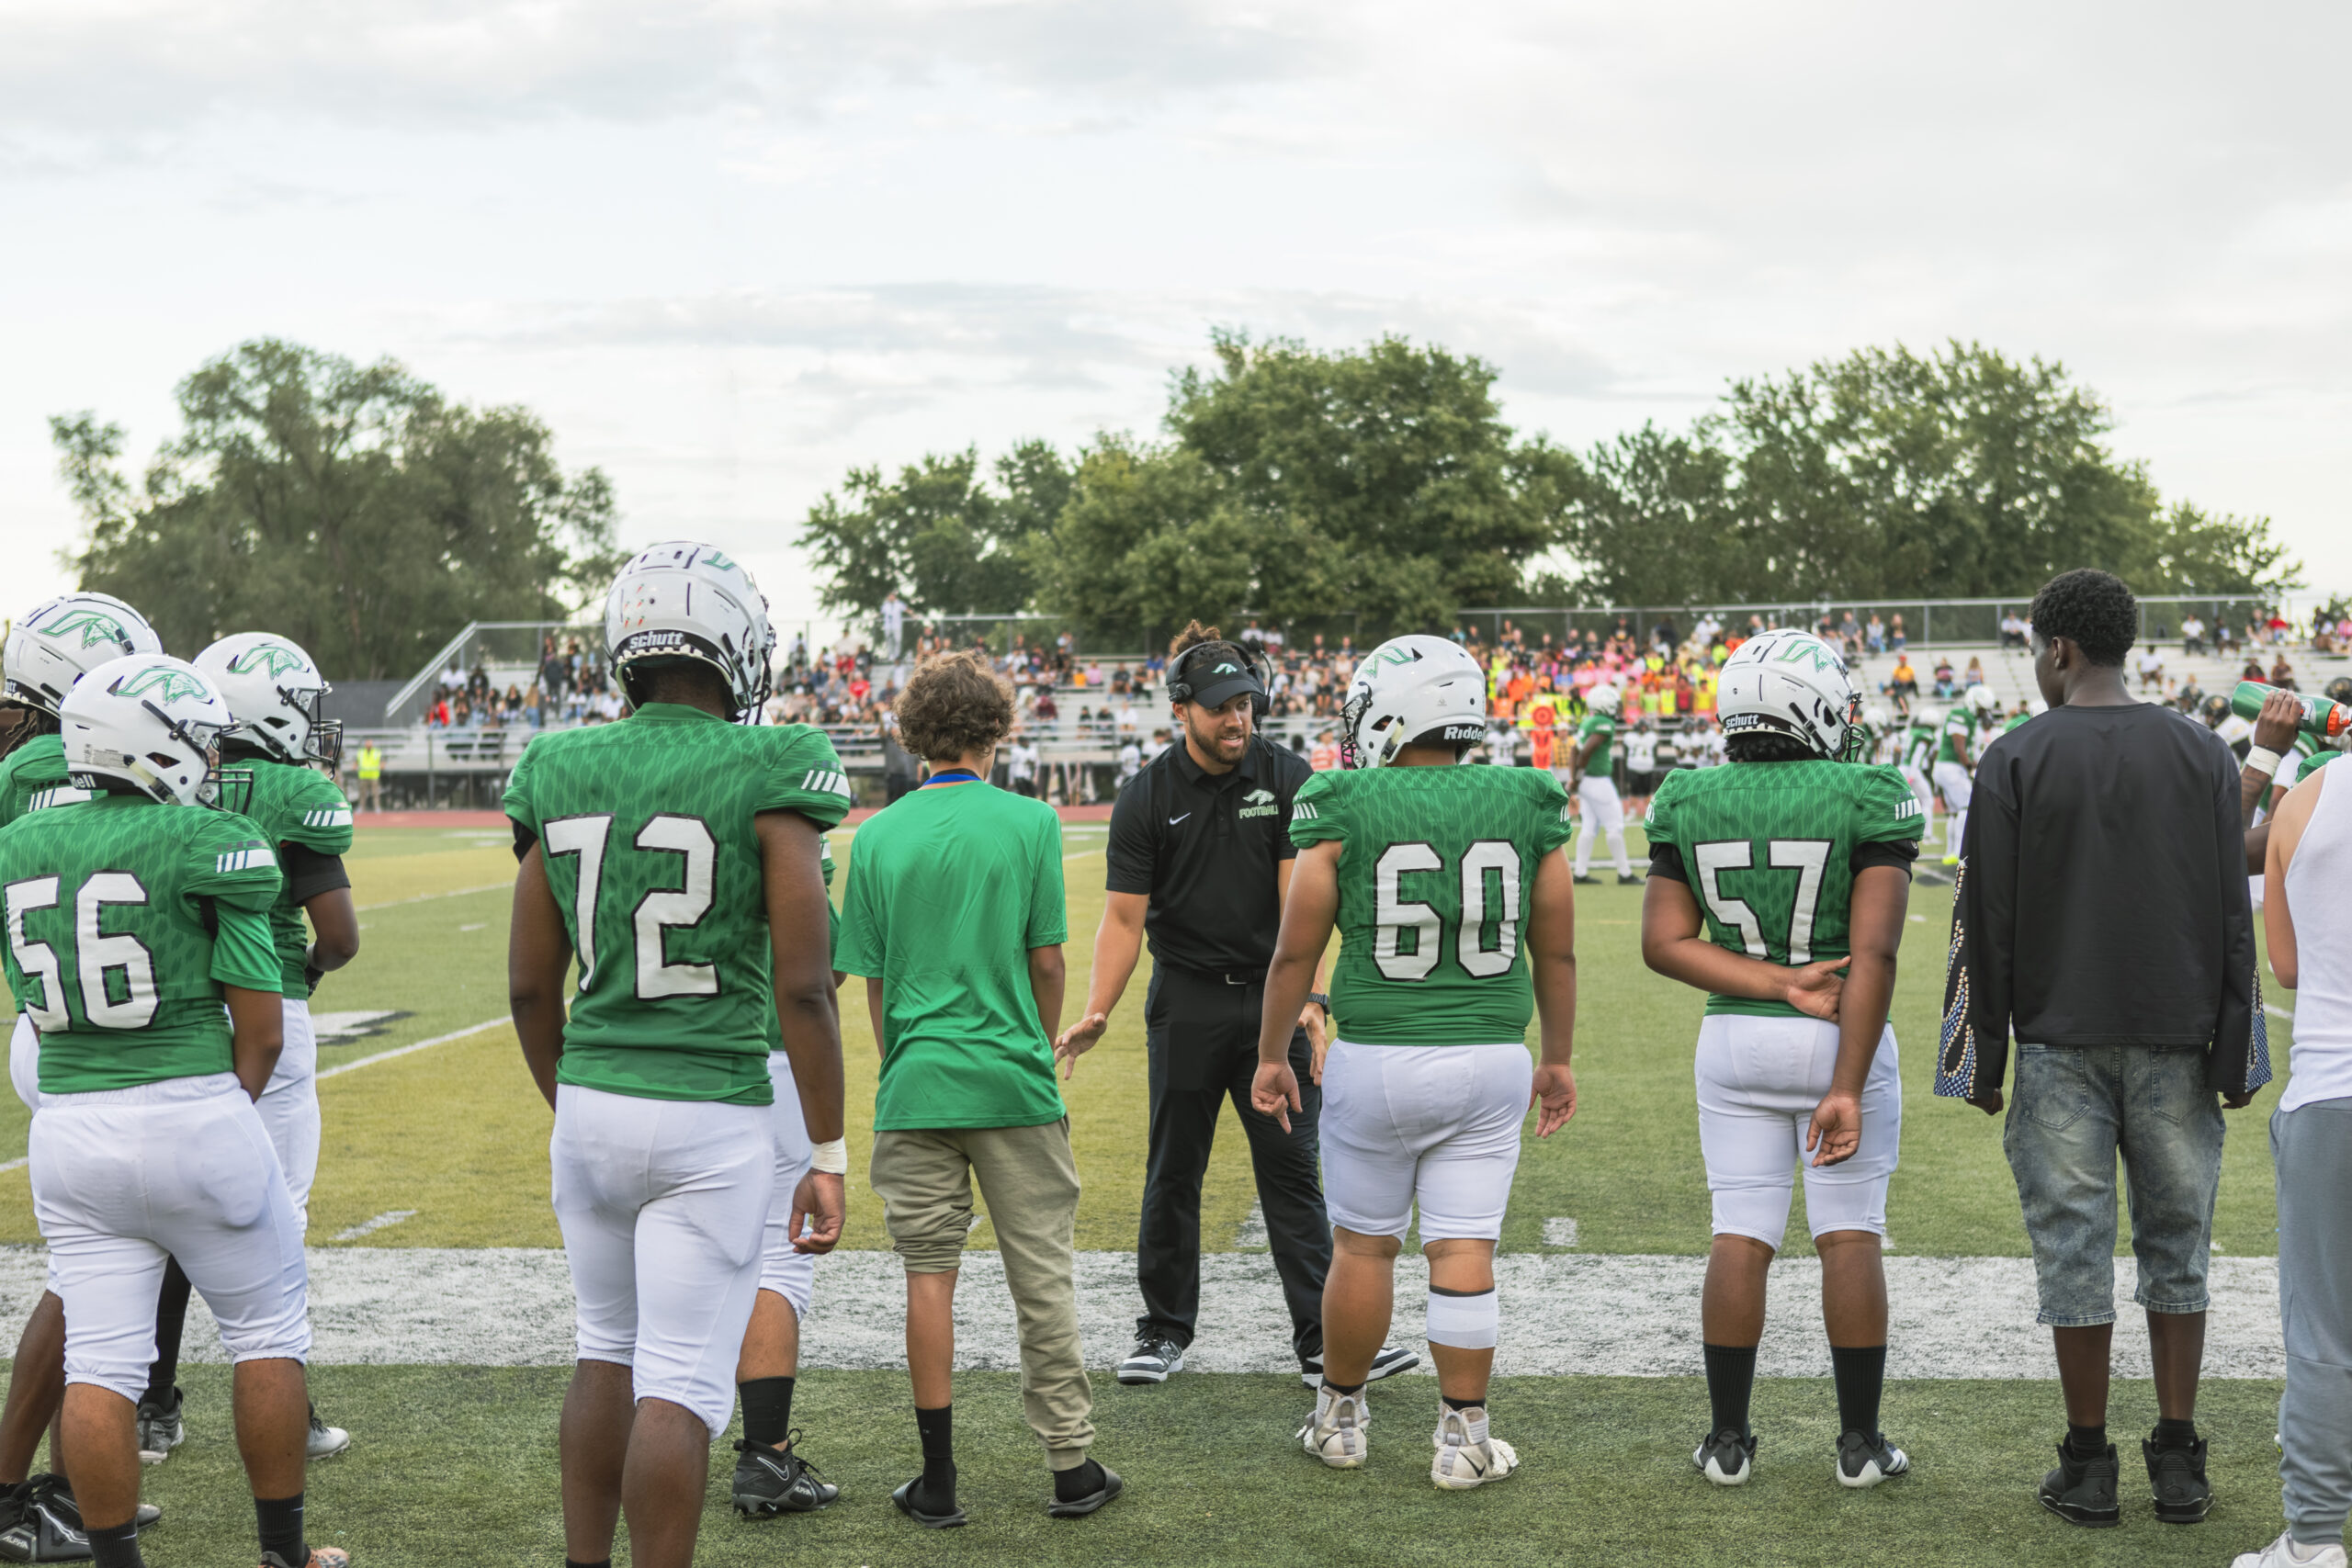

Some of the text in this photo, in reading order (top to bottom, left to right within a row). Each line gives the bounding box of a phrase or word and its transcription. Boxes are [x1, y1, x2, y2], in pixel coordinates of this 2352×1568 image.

[629, 630, 684, 649] schutt
[1725, 714, 1759, 728] schutt
[1238, 804, 1279, 819] FOOTBALL
[542, 811, 721, 1002] 72
[1372, 838, 1521, 983] 60
[1692, 837, 1836, 965] 57
[3, 869, 162, 1034] 56
[1, 1534, 30, 1551] ALPHA
